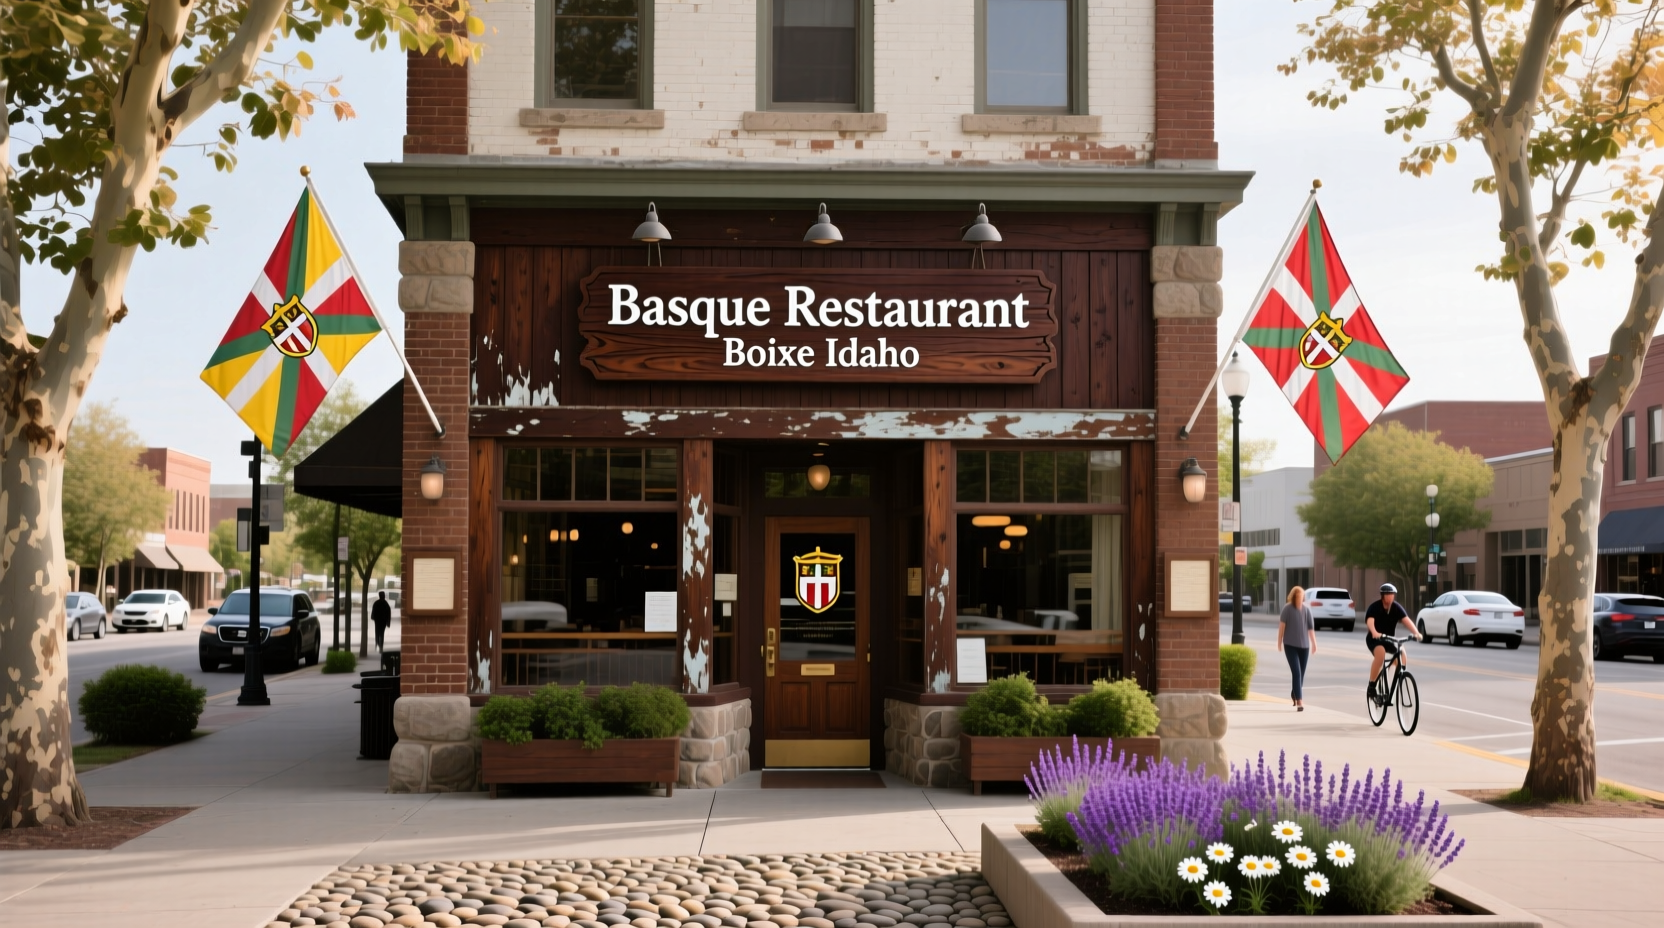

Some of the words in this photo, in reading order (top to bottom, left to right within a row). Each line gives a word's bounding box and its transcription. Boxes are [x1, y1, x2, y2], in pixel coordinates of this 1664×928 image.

[607, 283, 771, 339] Basque
[783, 285, 1030, 329] Restaurant
[722, 337, 815, 368] Boixe
[825, 336, 920, 368] Idaho
